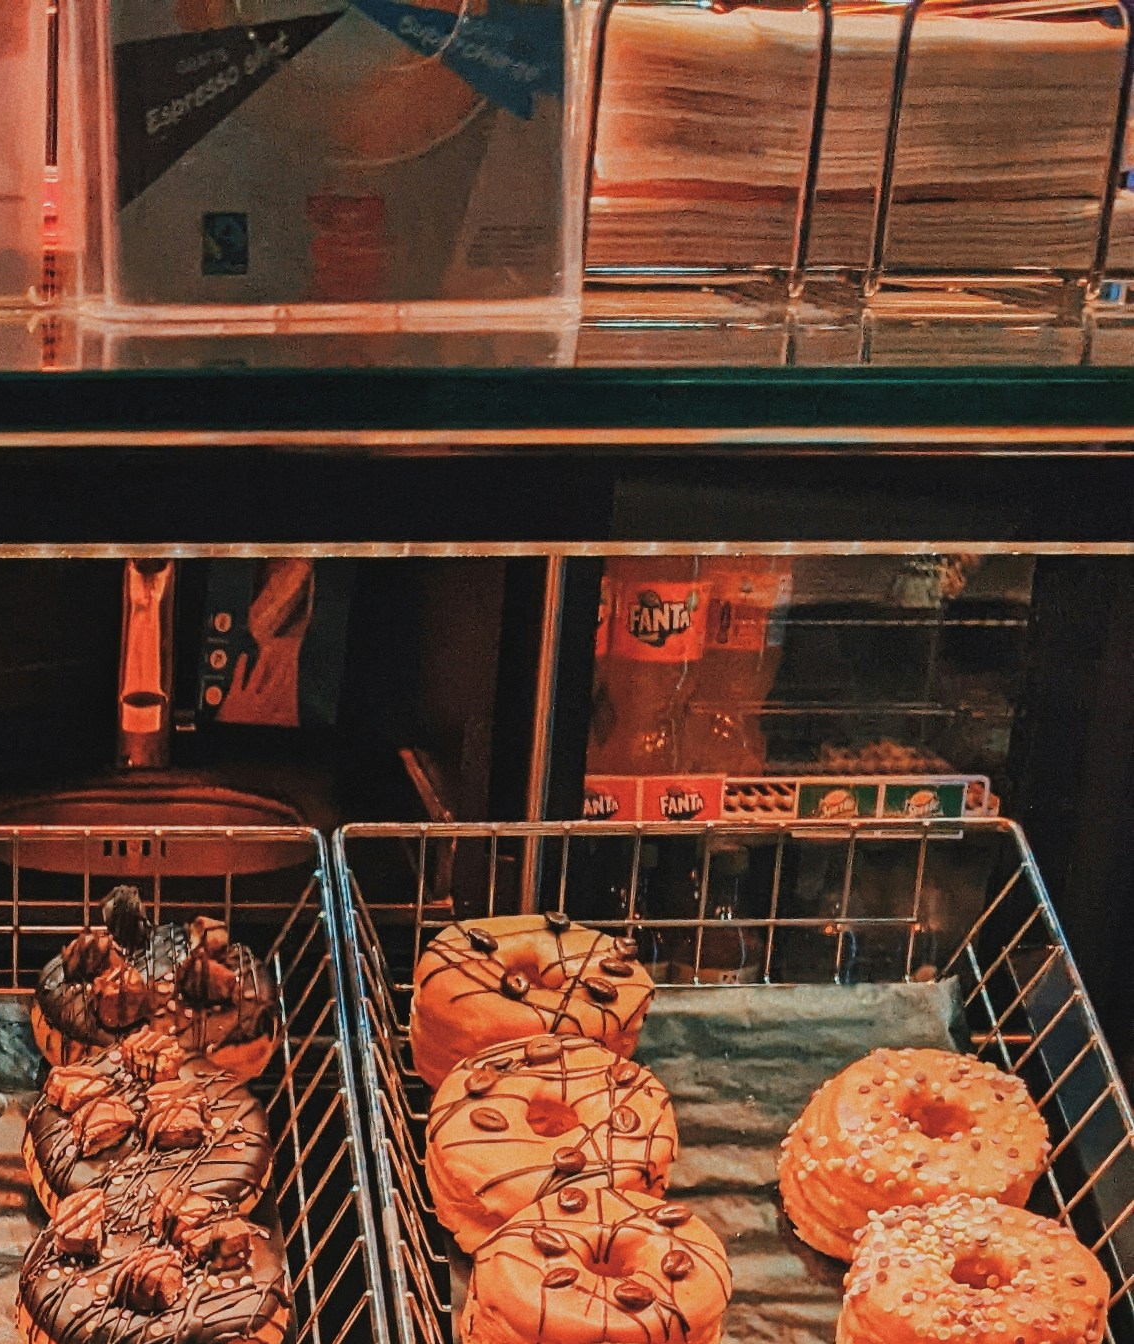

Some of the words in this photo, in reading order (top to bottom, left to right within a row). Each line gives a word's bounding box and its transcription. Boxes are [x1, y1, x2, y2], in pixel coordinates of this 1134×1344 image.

[629, 601, 692, 637] FANTA
[583, 794, 619, 816] ANTA
[659, 792, 704, 816] FANTA
